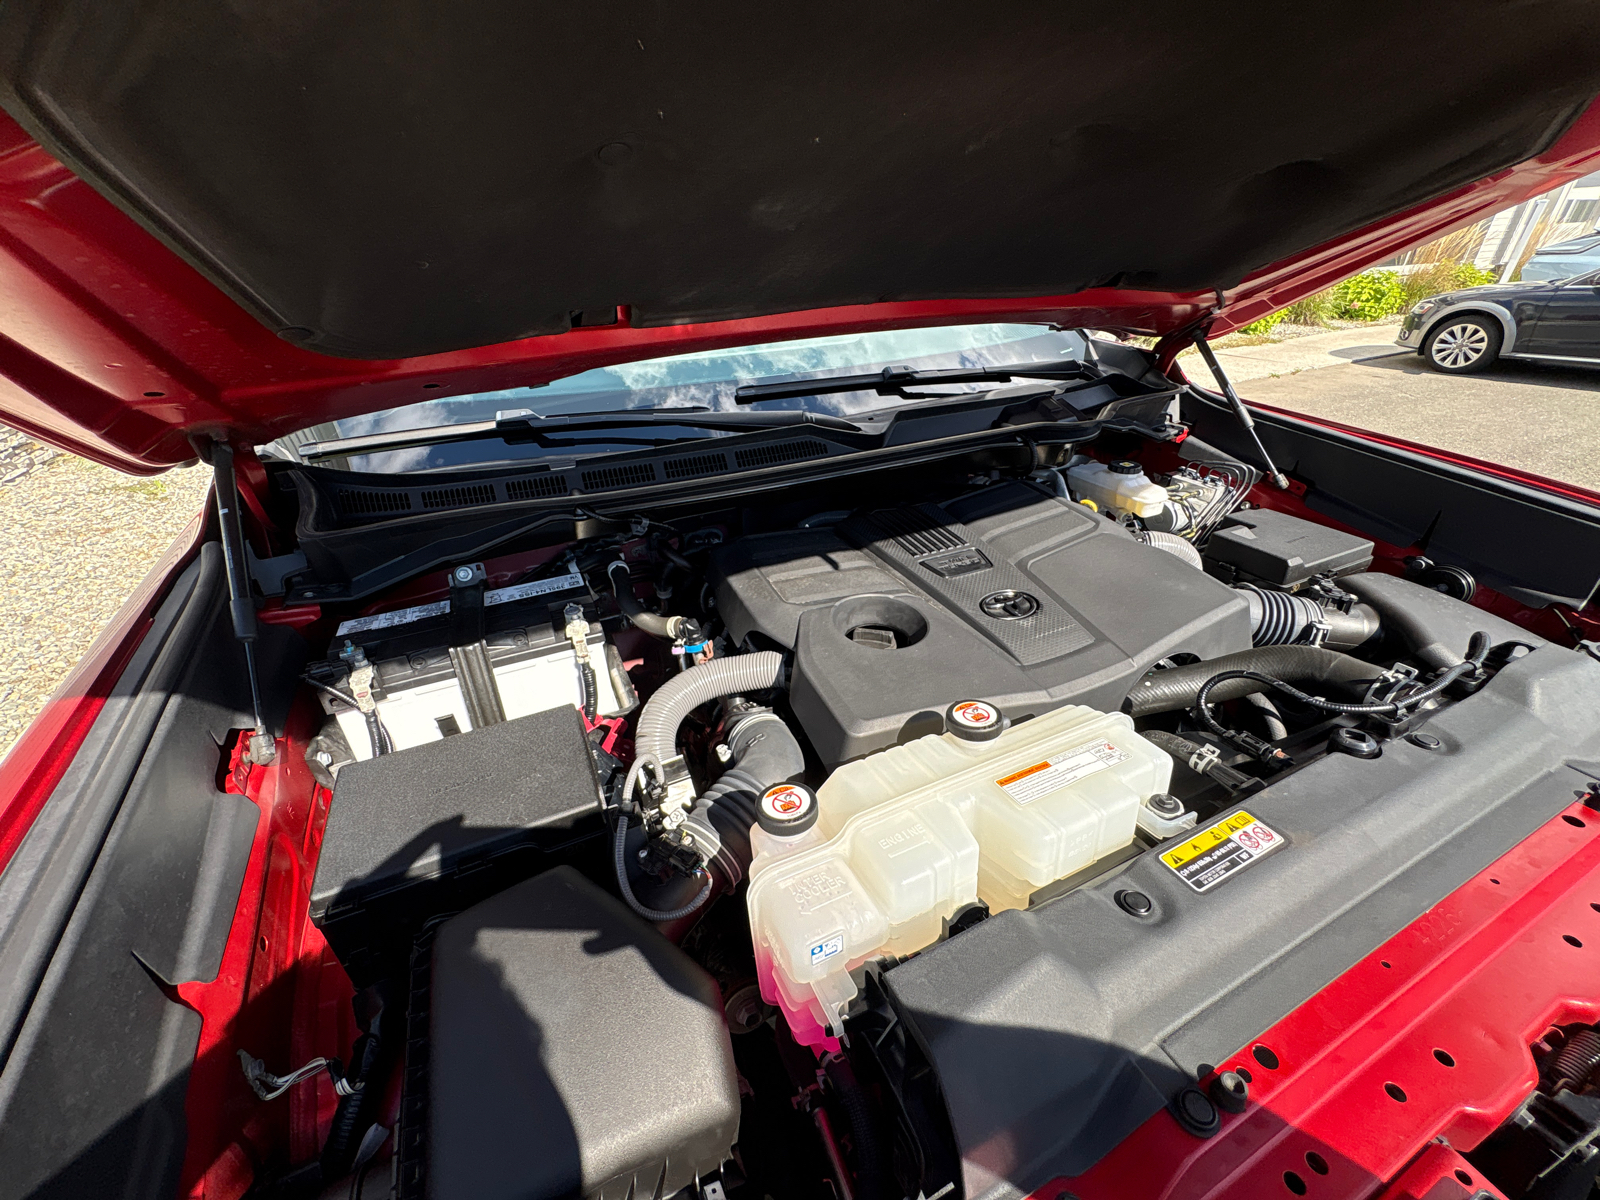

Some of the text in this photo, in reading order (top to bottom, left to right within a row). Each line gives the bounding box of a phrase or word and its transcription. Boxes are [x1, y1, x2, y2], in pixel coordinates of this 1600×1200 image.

[878, 823, 926, 850] ENGINE
[788, 871, 831, 896] INTER
[794, 876, 846, 904] COOLER
